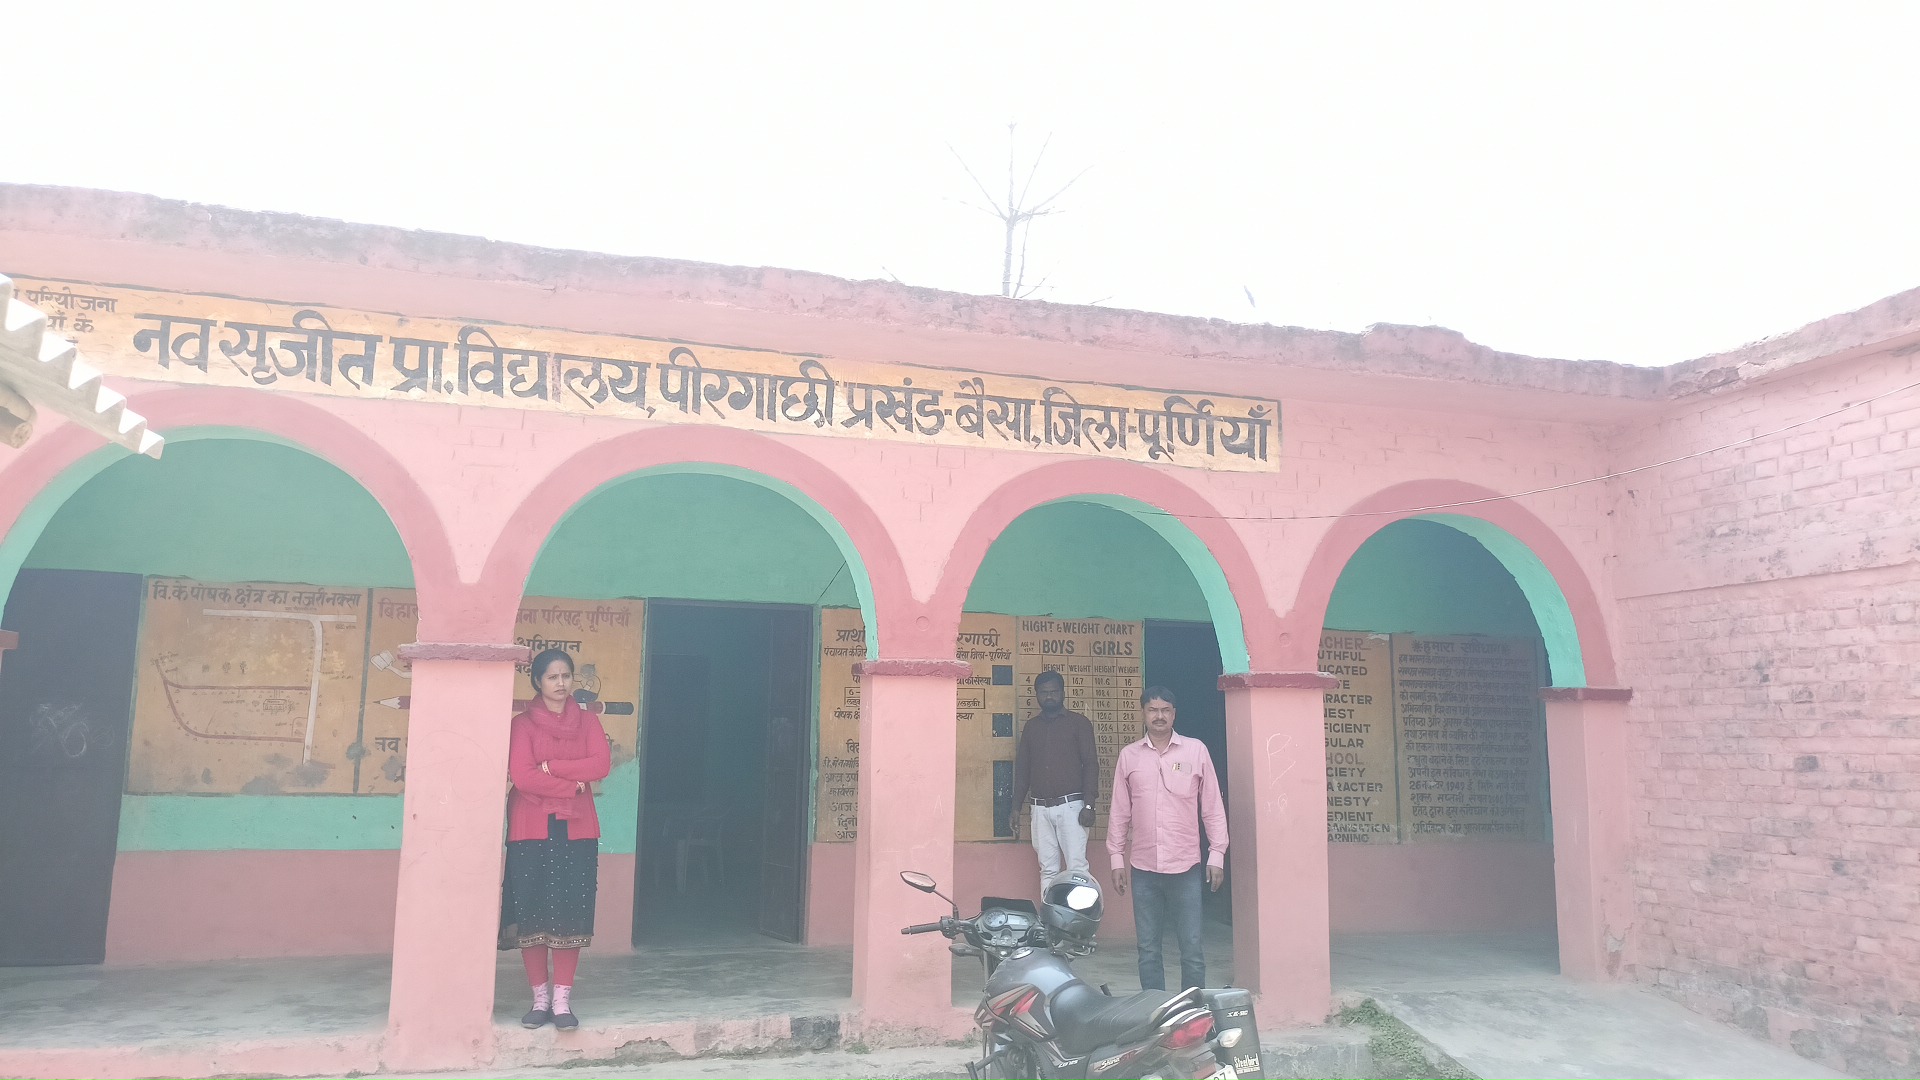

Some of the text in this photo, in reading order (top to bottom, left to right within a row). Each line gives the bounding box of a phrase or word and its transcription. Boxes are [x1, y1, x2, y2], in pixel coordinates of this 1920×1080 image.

[73, 313, 95, 333] के
[133, 312, 217, 373] नव
[190, 583, 232, 604] पोषक
[235, 585, 266, 608] क्षेत्र
[267, 588, 289, 604] का
[584, 606, 632, 633] पूर्णियाँ
[1063, 622, 1101, 635] WEIGHT
[1104, 624, 1135, 637] CHART
[957, 628, 1001, 647] रगाछी
[1042, 639, 1133, 656] BOYS GIRLS
[1318, 649, 1366, 662] UTHFUL
[1068, 665, 1092, 673] WEIGHT
[1094, 665, 1115, 674] HEIGHT
[1118, 666, 1139, 674] WEIGHT
[1318, 664, 1368, 676] UCATED
[1125, 679, 1132, 687] 16
[1026, 687, 1032, 695] 5
[1323, 693, 1373, 705] RACTER
[1027, 711, 1032, 719] 7
[1326, 752, 1362, 765] HOOL
[1326, 767, 1366, 778] CIETY
[1327, 782, 1384, 792] ARACTER
[1409, 780, 1421, 790] 26
[1327, 796, 1371, 807] NESTY
[1327, 811, 1374, 822] EDIENT
